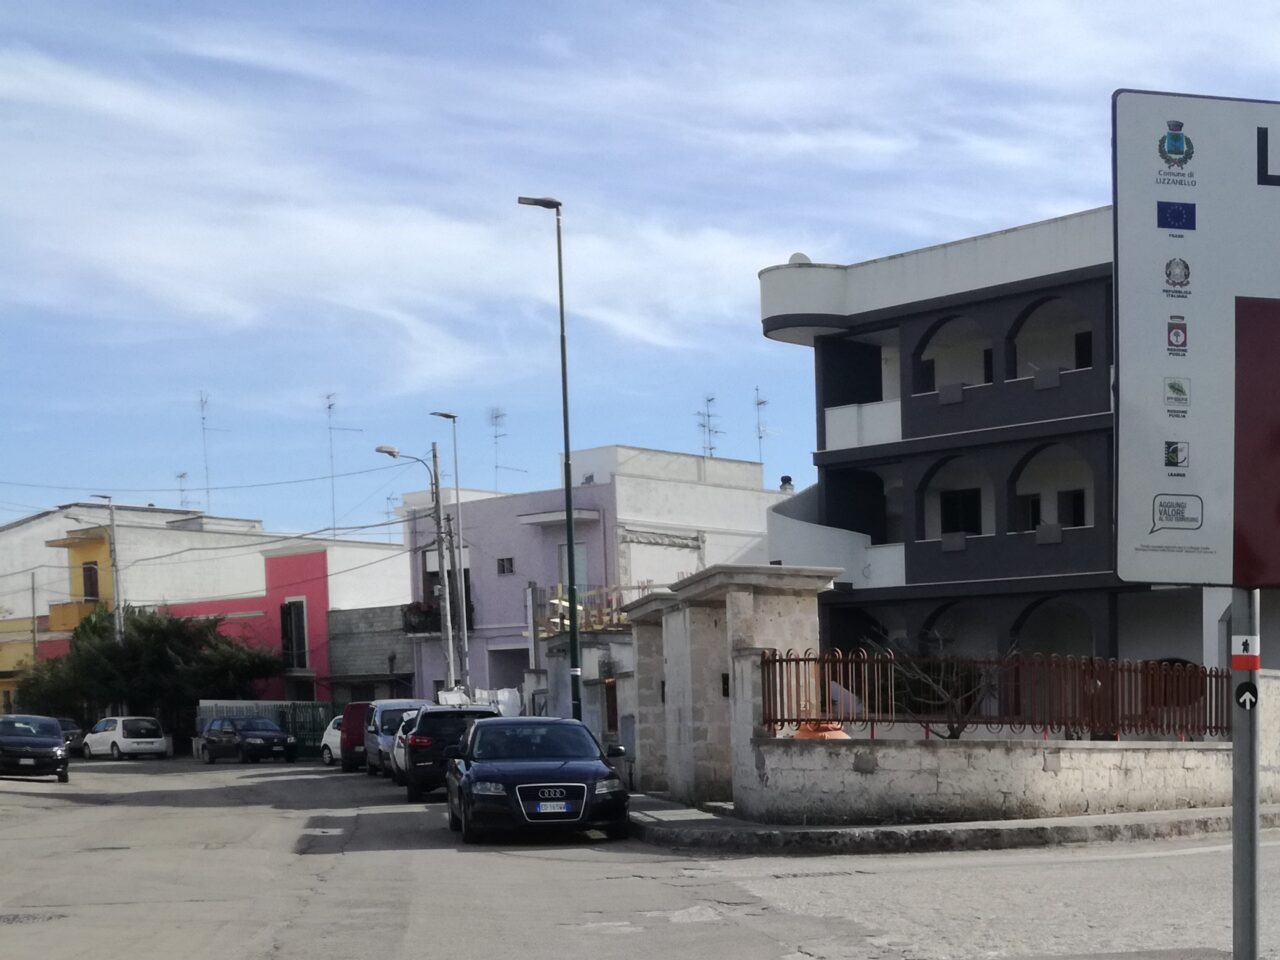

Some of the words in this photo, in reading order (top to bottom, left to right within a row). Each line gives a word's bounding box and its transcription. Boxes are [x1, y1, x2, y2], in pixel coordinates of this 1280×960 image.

[1158, 169, 1186, 178] Comune
[1187, 170, 1195, 179] di
[1156, 178, 1197, 187] LIZZANELLO
[1159, 508, 1185, 517] VALORE
